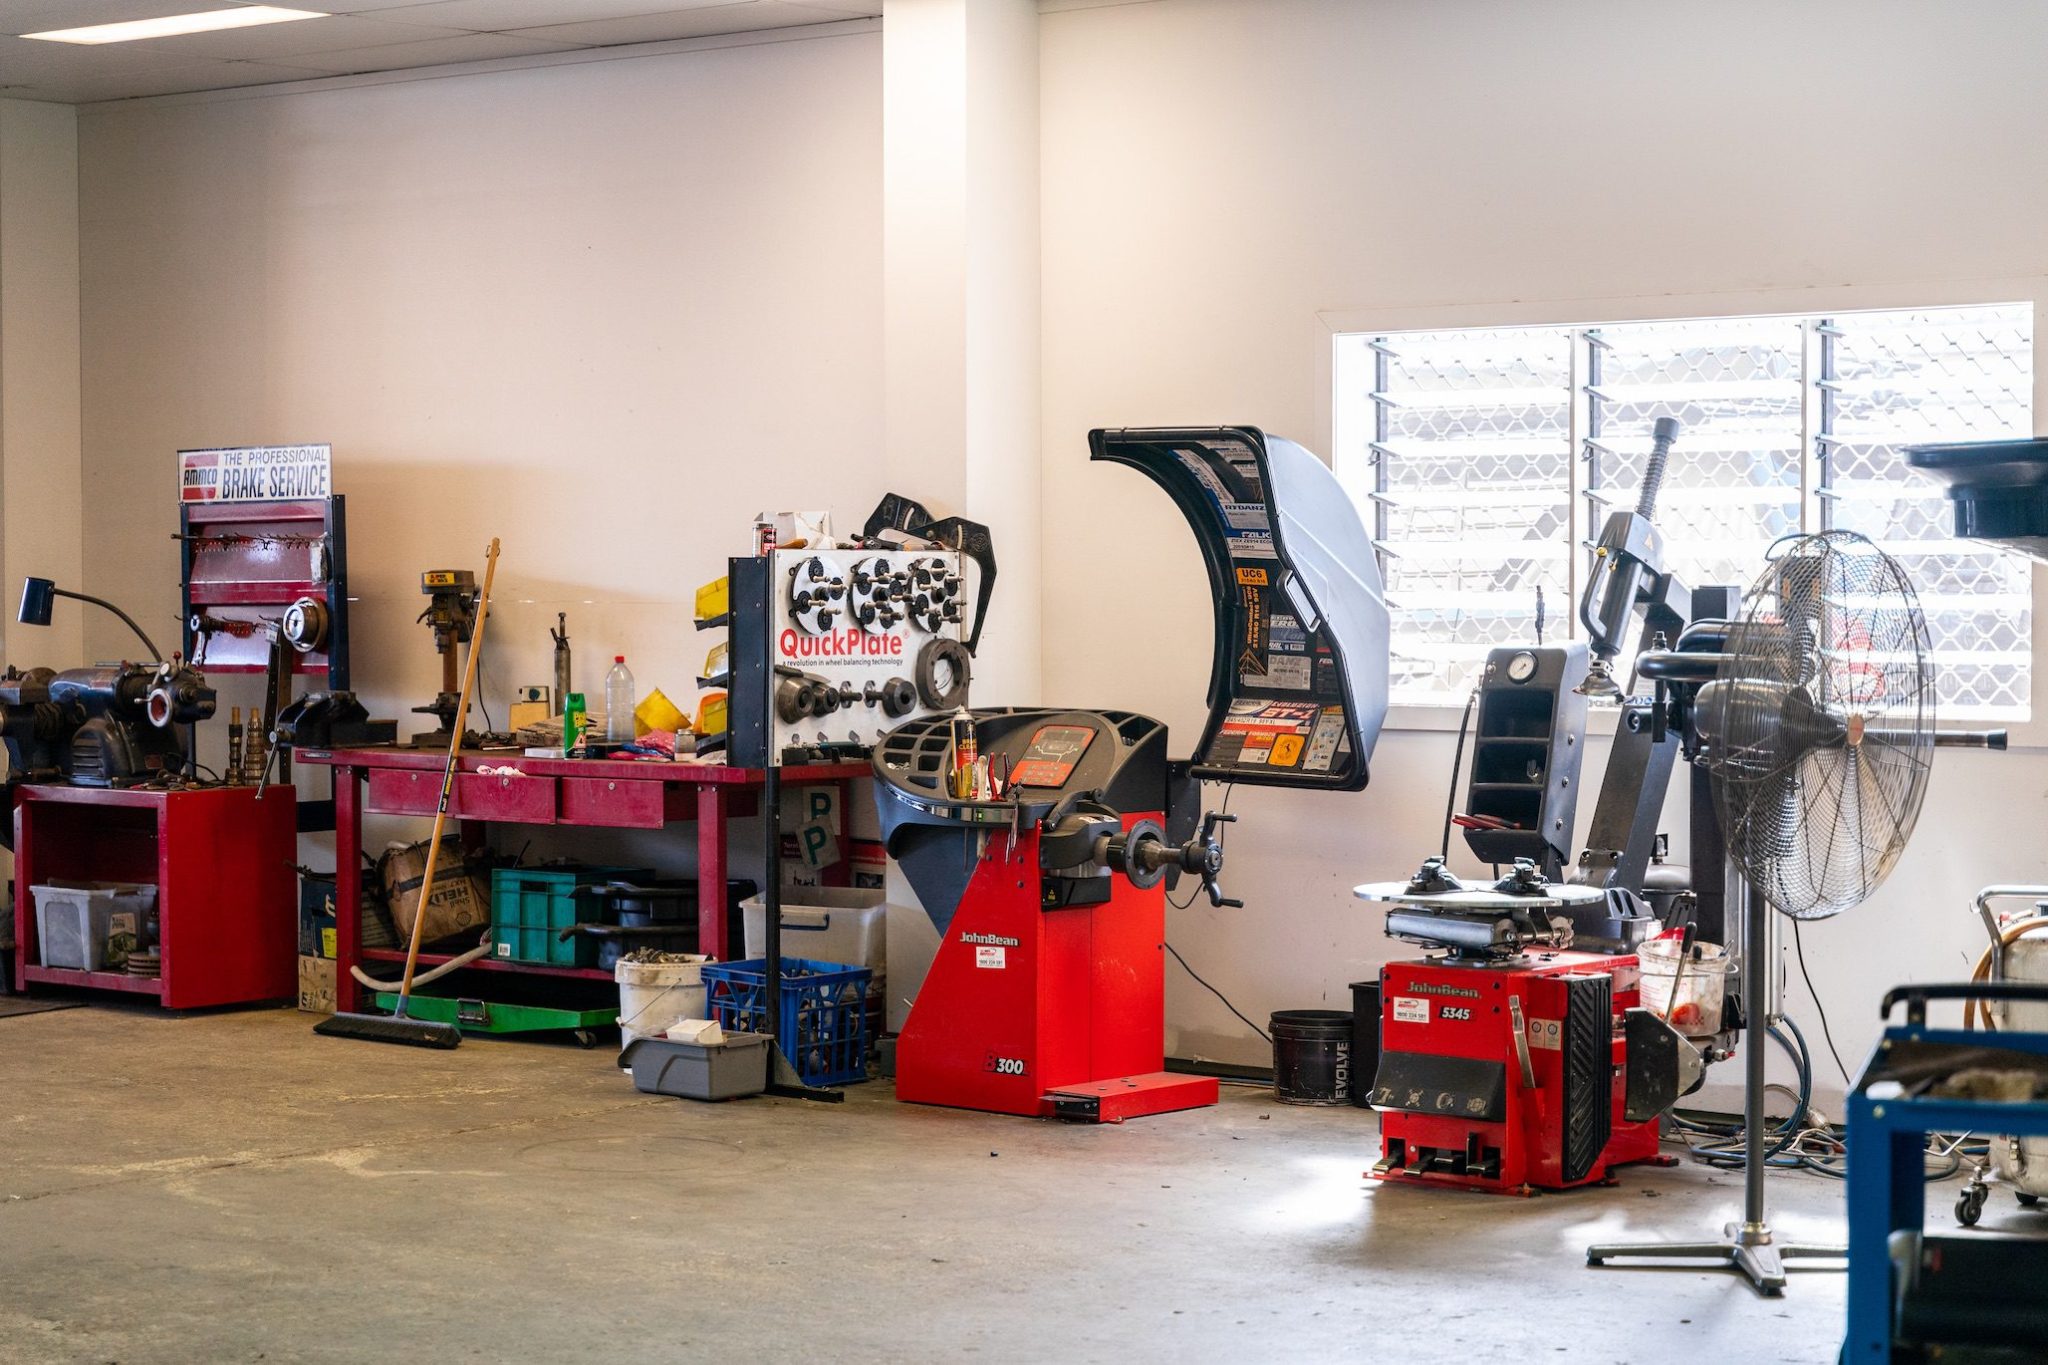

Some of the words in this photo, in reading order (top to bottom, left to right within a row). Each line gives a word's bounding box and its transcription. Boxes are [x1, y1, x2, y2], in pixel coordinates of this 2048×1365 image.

[224, 453, 243, 466] THE
[248, 449, 327, 465] PROFESSIONAL
[183, 468, 218, 486] AMMCO
[222, 467, 266, 499] BRAKE
[269, 464, 327, 497] SERVICE
[1242, 569, 1262, 578] UC6
[780, 628, 902, 658] QuickPlate
[787, 659, 818, 667] revolution
[818, 659, 825, 667] in
[825, 658, 843, 667] wheel
[843, 657, 872, 668] balancing
[872, 656, 903, 667] technology
[810, 792, 832, 820] P
[803, 825, 827, 866] P
[960, 931, 1019, 946] JohnBean
[1407, 981, 1479, 999] JohnBean
[1441, 1006, 1472, 1021] 5345
[1335, 1042, 1349, 1099] EVOLVE
